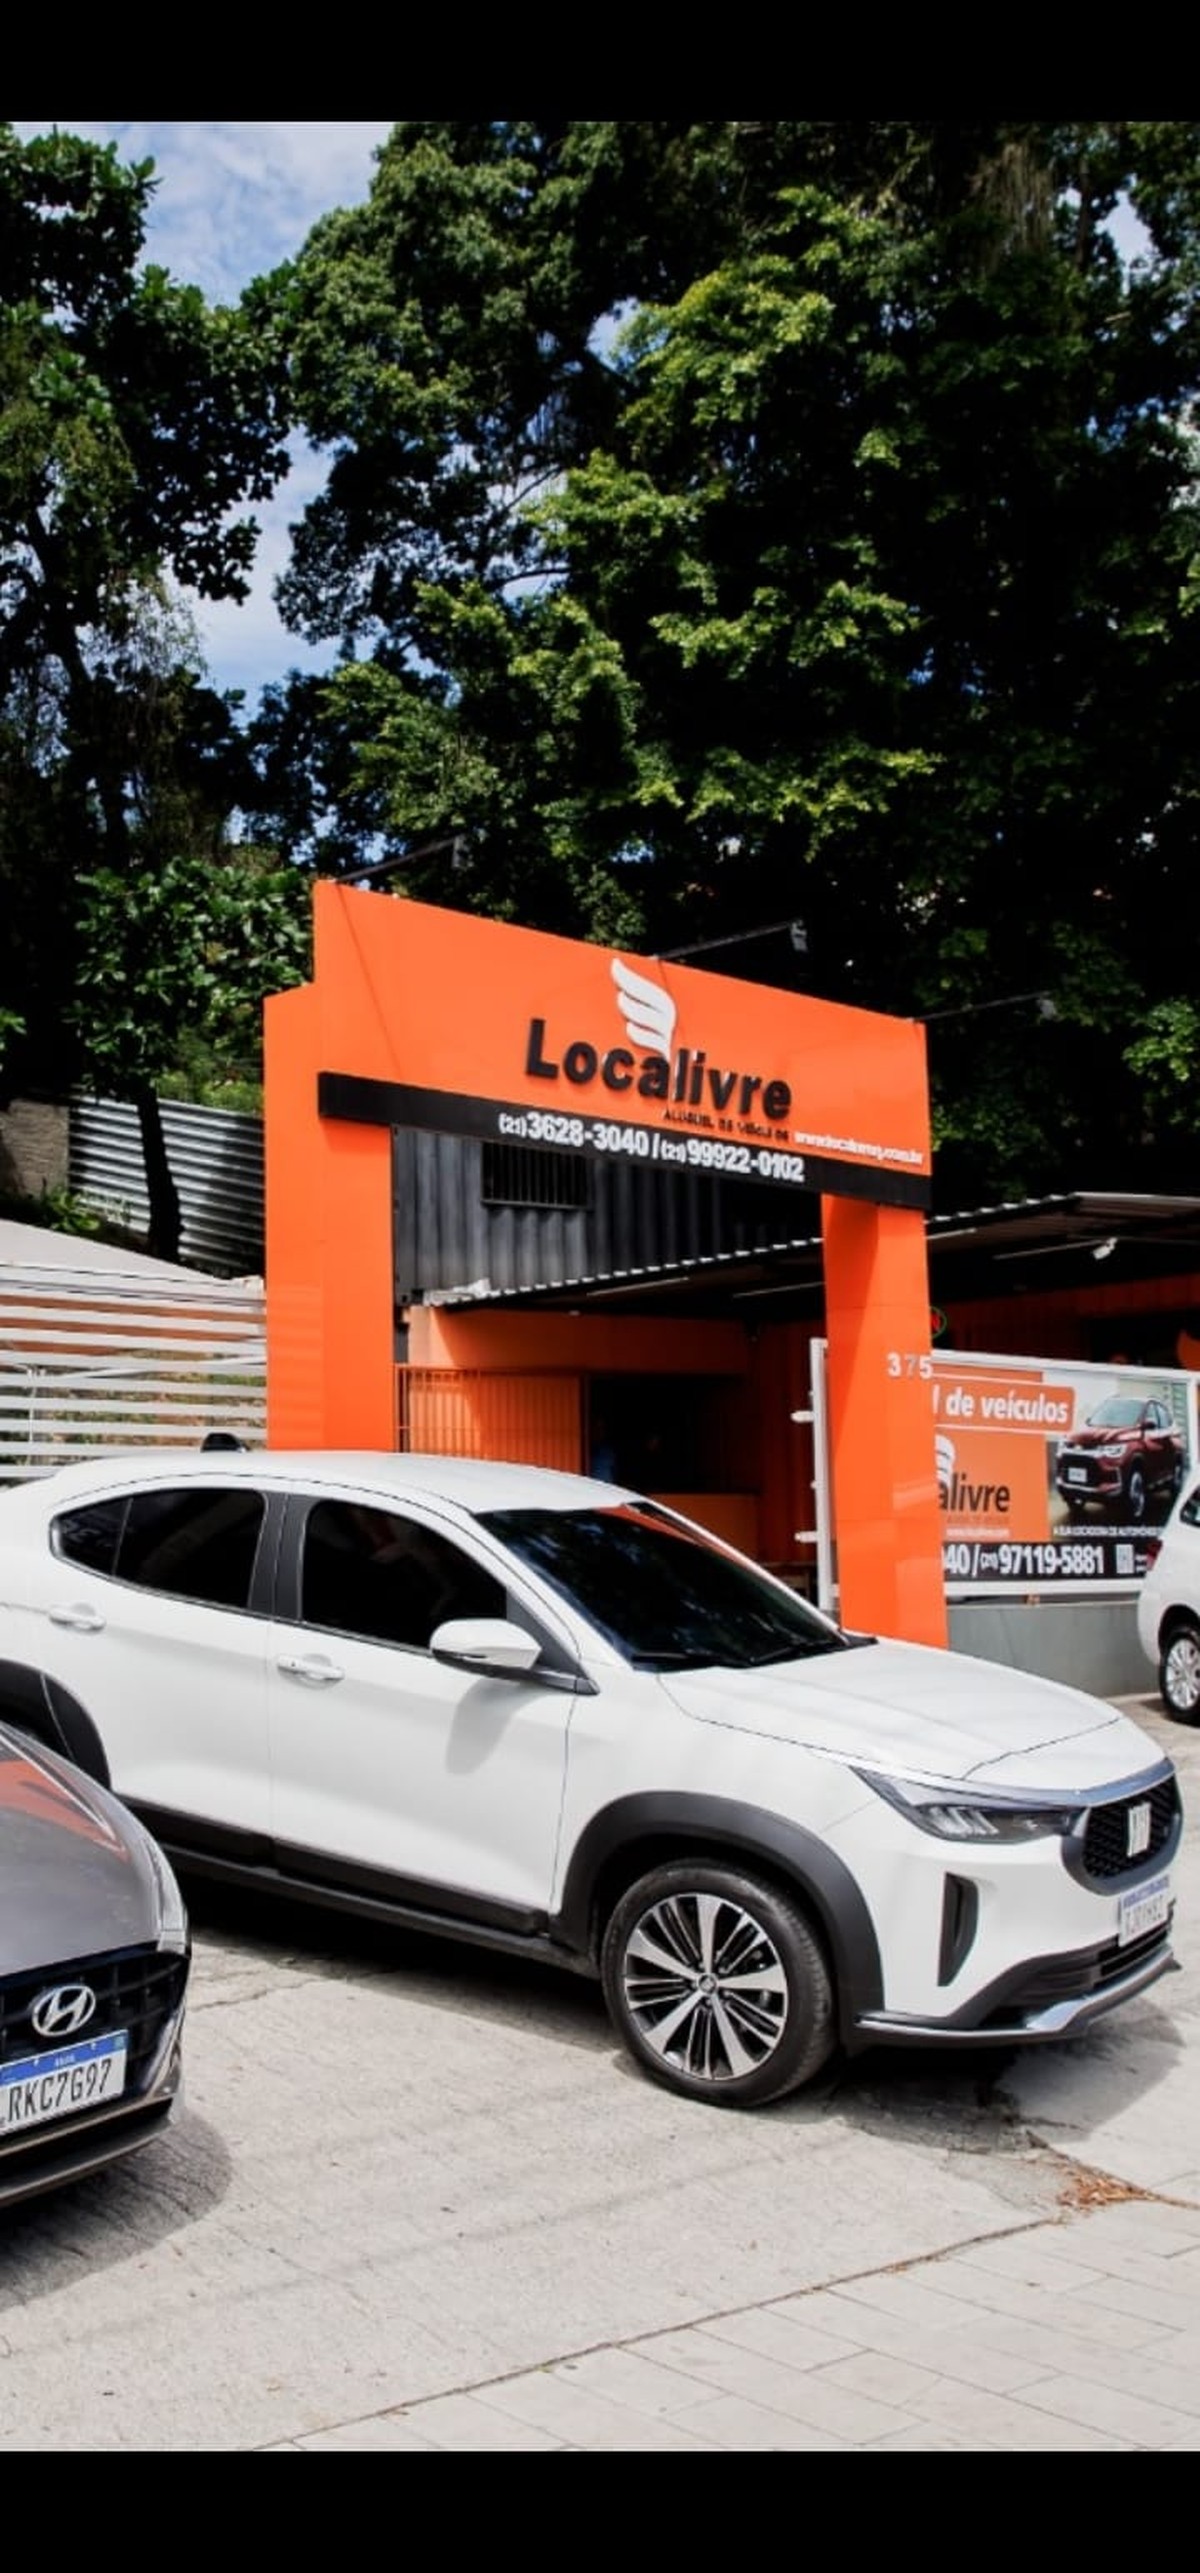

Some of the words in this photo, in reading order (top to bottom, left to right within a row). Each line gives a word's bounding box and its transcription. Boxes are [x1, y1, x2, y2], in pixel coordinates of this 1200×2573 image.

[525, 1018, 792, 1120] Localivre
[887, 1351, 933, 1380] 375
[945, 1386, 974, 1417] de
[981, 1390, 1069, 1423] veículos
[938, 1472, 1010, 1513] alivre
[8, 2058, 112, 2122] RKC7G97
